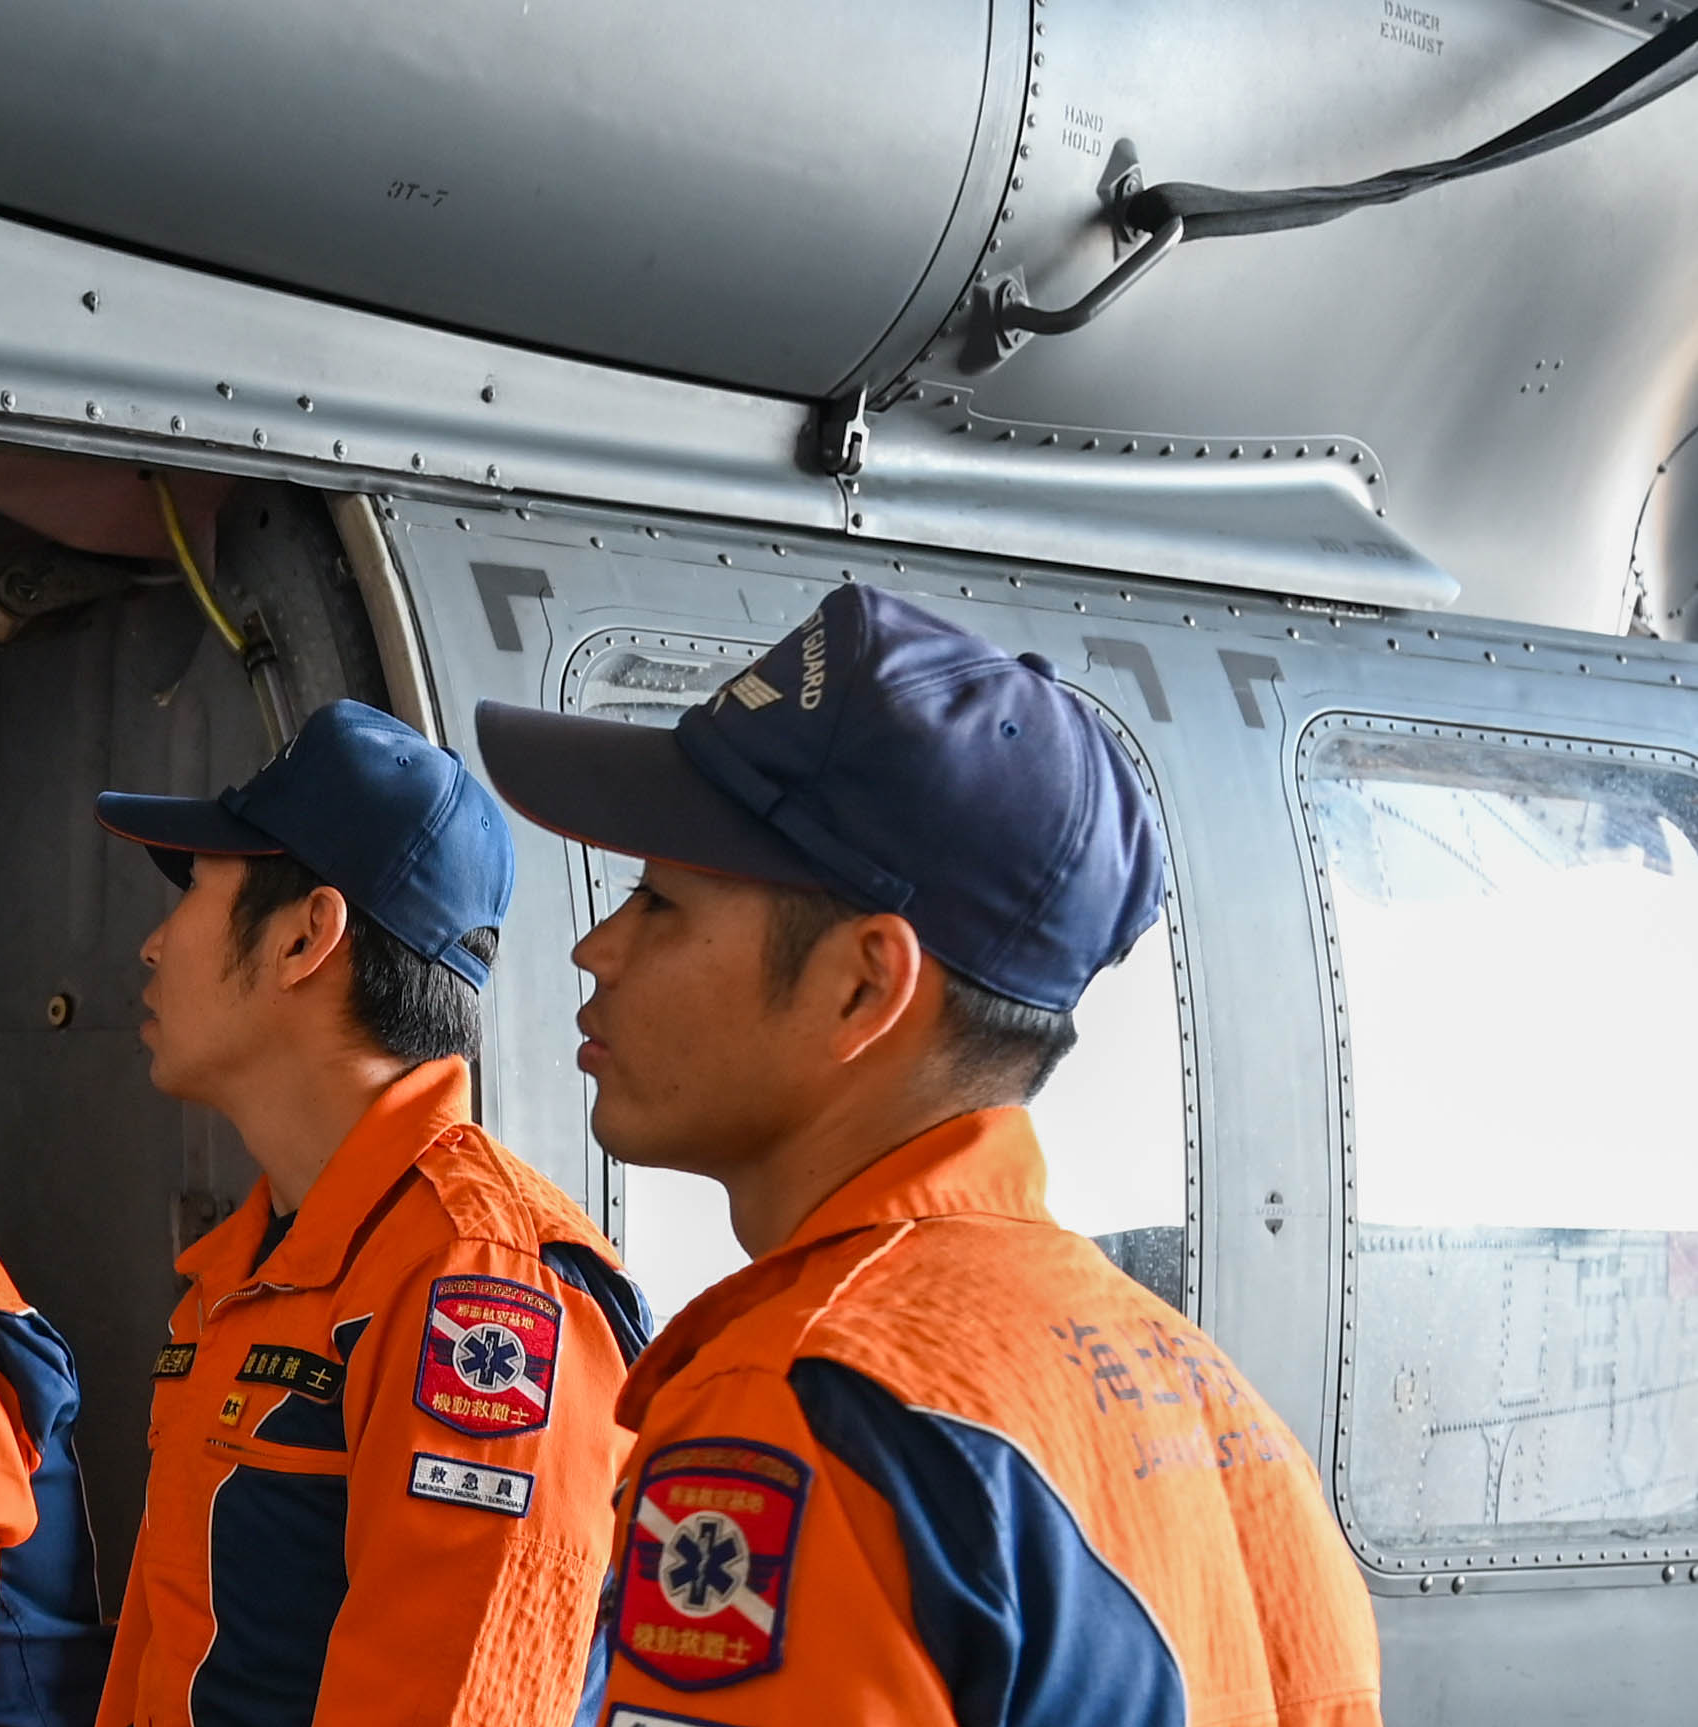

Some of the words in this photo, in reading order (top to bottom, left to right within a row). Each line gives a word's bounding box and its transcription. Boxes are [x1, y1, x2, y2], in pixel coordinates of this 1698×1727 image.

[1384, 0, 1440, 32] DANGER
[1380, 22, 1444, 56] EXHAUST
[1064, 104, 1103, 132] HAND
[1062, 129, 1101, 156] HOLD
[387, 181, 449, 207] 3T-7
[801, 629, 825, 710] GUARD
[432, 1392, 530, 1426] 機動救難士
[429, 1465, 512, 1498] 救急員
